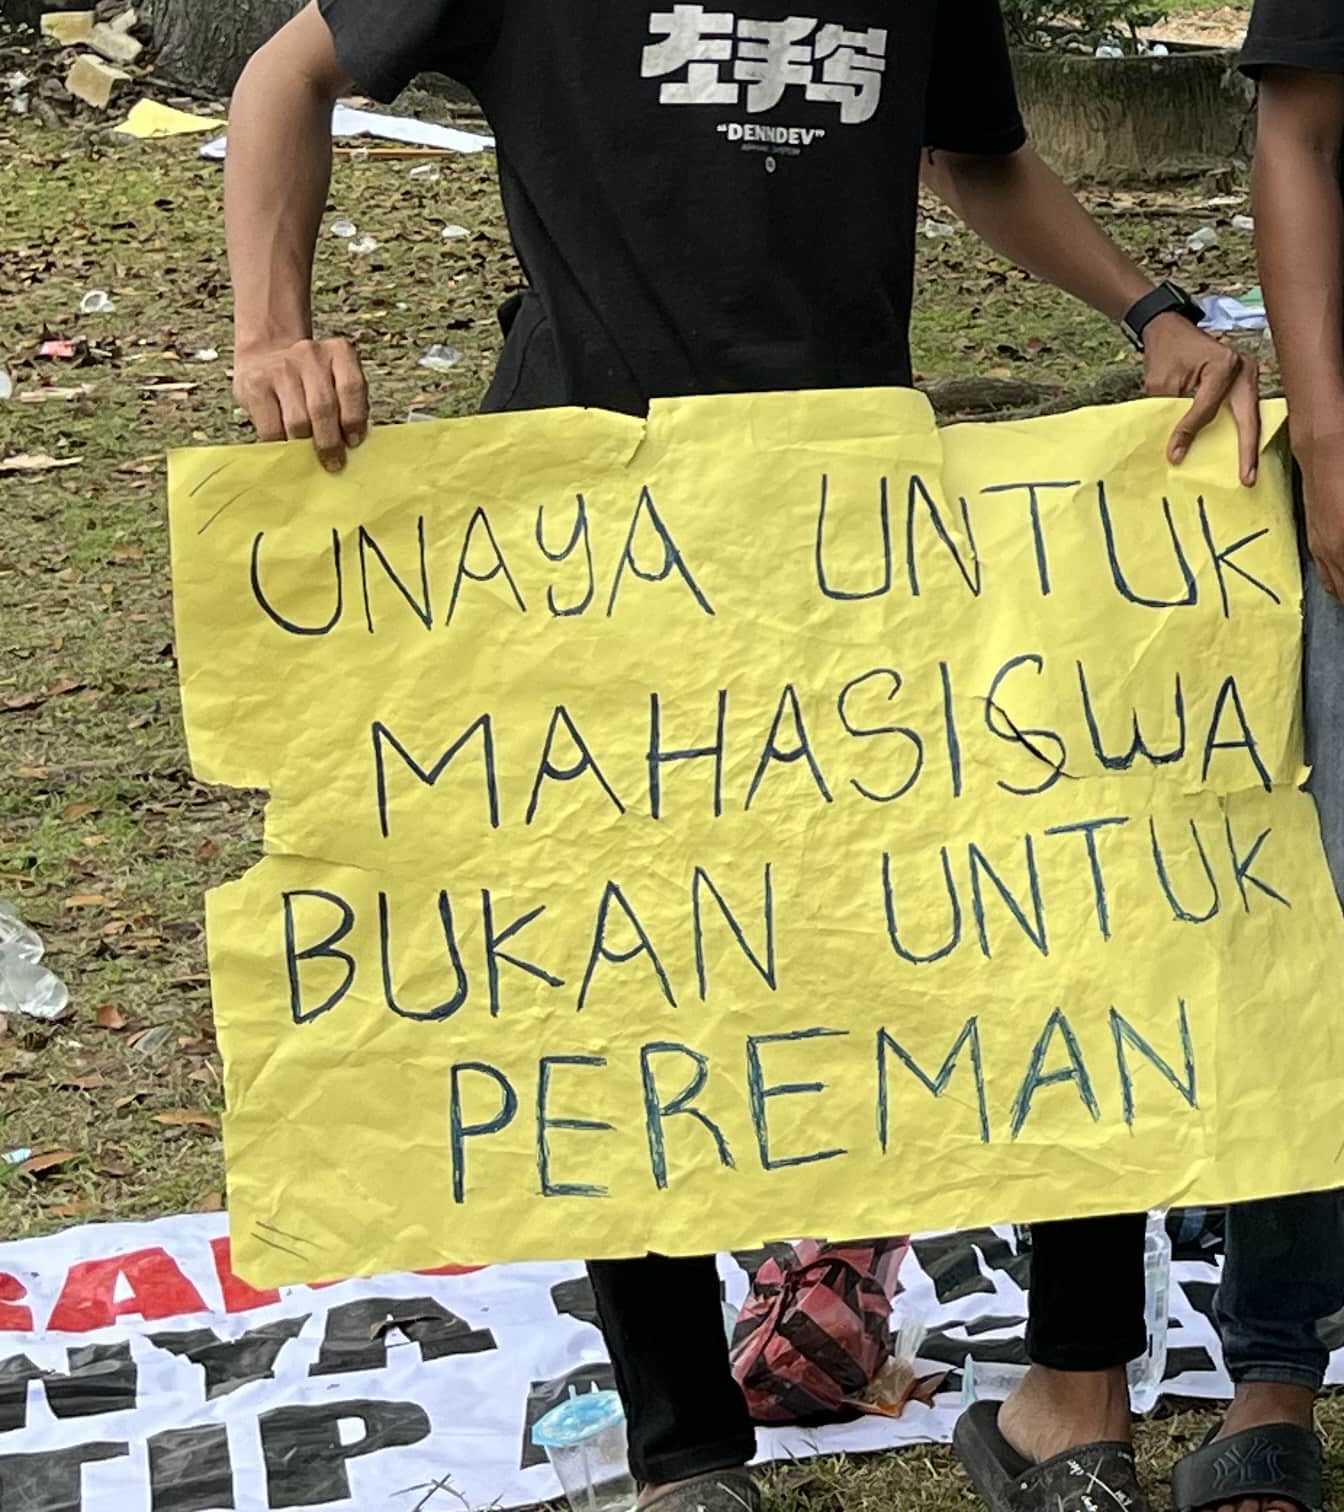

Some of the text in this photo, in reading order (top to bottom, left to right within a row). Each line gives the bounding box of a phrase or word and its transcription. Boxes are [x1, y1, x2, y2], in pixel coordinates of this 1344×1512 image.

[250, 473, 1284, 636] UNAYA UNTUK
[371, 653, 1274, 838] MAHASISWA
[282, 813, 1292, 1026] BUKAN UNTUK
[449, 997, 1199, 1204] PEREMAN
